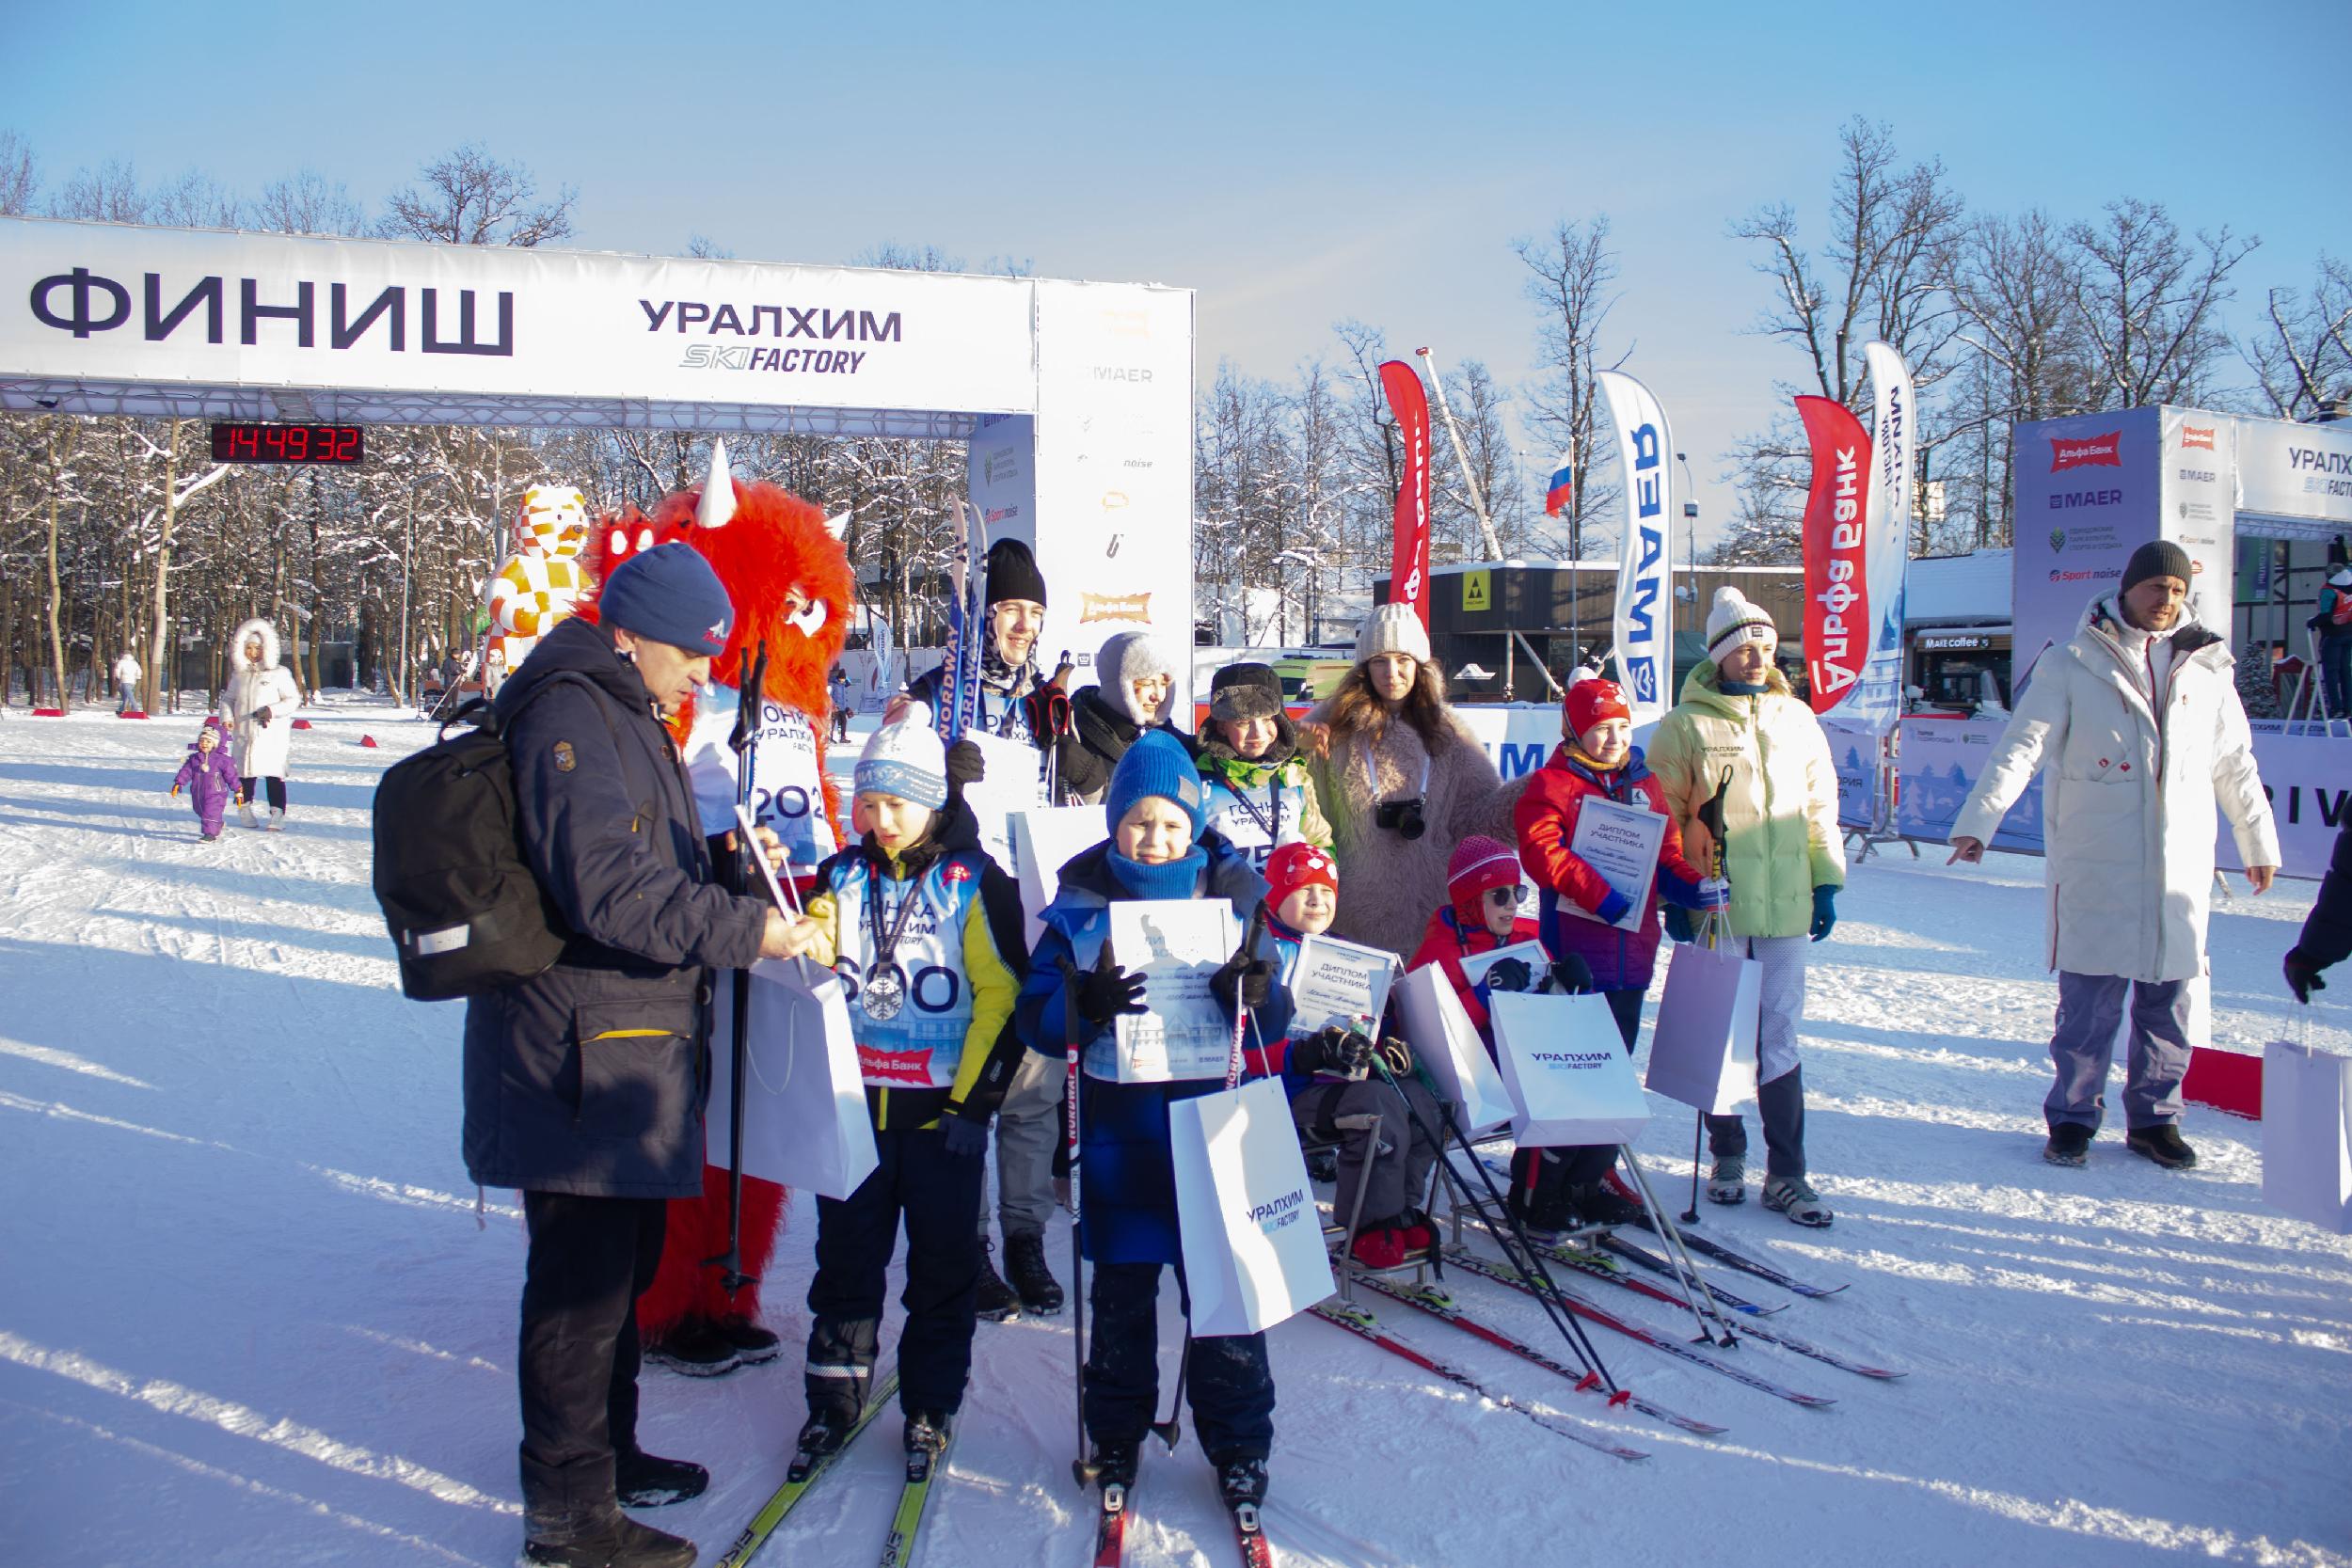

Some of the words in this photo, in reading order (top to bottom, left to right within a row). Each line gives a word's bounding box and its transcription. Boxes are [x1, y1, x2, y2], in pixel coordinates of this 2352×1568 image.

[29, 266, 514, 356] ФИНИШ
[639, 299, 901, 342] УРАЛХИМ
[228, 429, 258, 457] 14
[264, 428, 308, 460] 49
[316, 429, 358, 461] 32
[2059, 447, 2089, 462] Альфа
[2090, 444, 2114, 455] Банк
[2066, 489, 2122, 508] MAER
[2061, 569, 2091, 581] Sport
[2092, 567, 2122, 578] noise
[938, 625, 959, 740] NORDWAY
[1590, 830, 1645, 849] УЧАСТНИКА
[1598, 823, 1641, 840] ДИПЛОМ
[1311, 971, 1372, 990] УЧАСТНИКА
[1321, 963, 1367, 980] ДИПЛОМ
[892, 1059, 922, 1071] Банк
[1532, 1052, 1612, 1062] УРАЛХИМ
[1247, 1189, 1304, 1223] УРАЛХИМ
